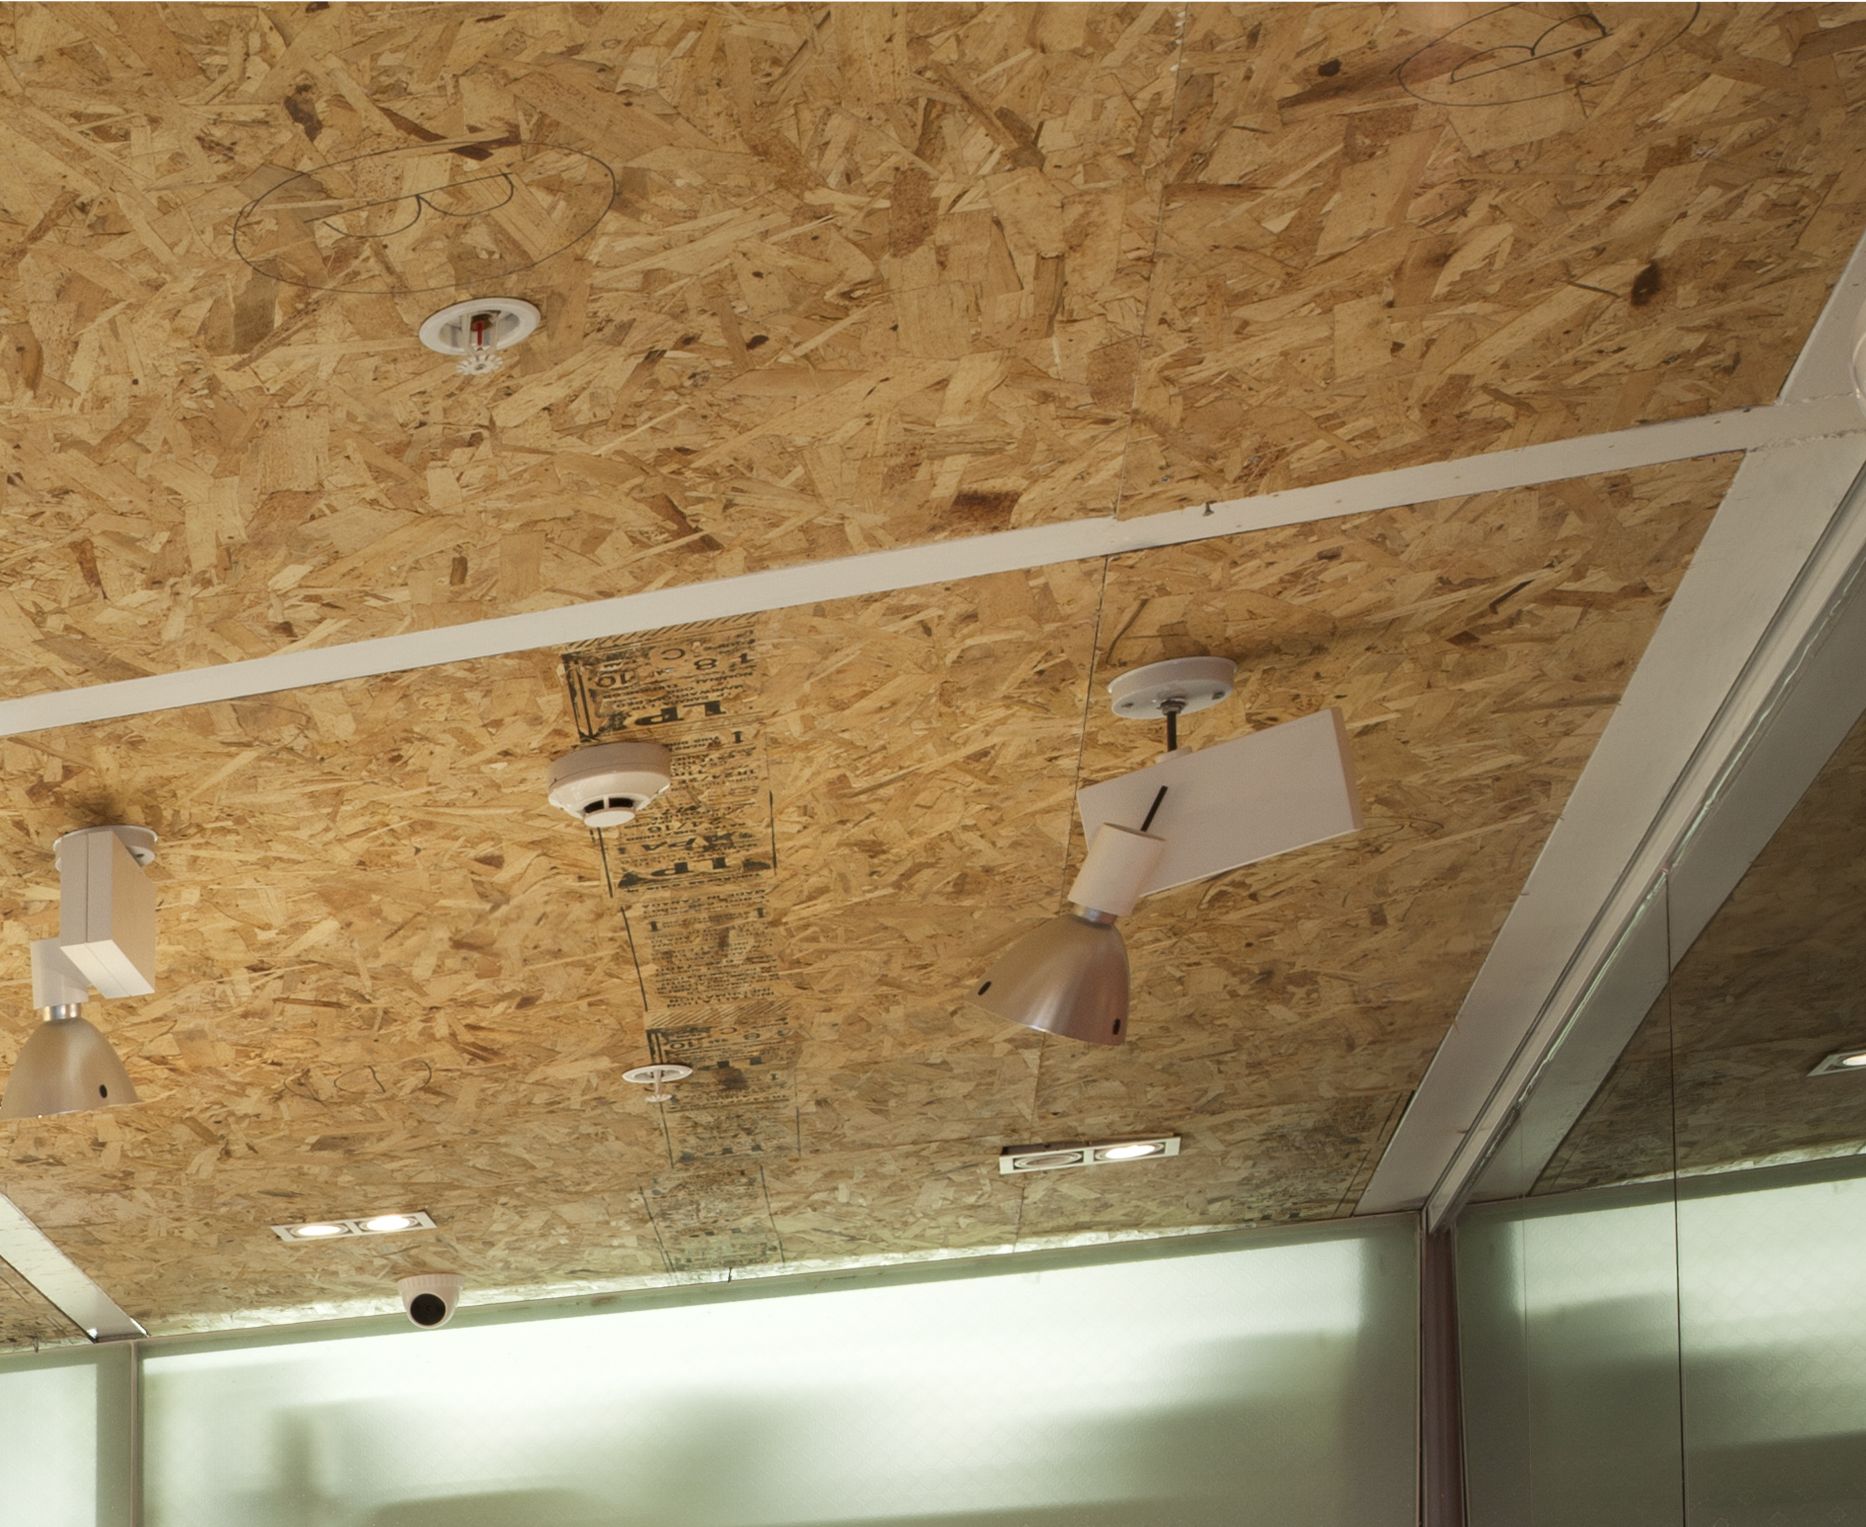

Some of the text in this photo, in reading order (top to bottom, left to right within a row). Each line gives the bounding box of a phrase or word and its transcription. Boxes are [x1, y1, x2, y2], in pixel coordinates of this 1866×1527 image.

[661, 648, 685, 659] C
[693, 658, 717, 669] 8
[594, 674, 628, 687] 10
[636, 701, 727, 727] LP
[649, 857, 728, 875] LP
